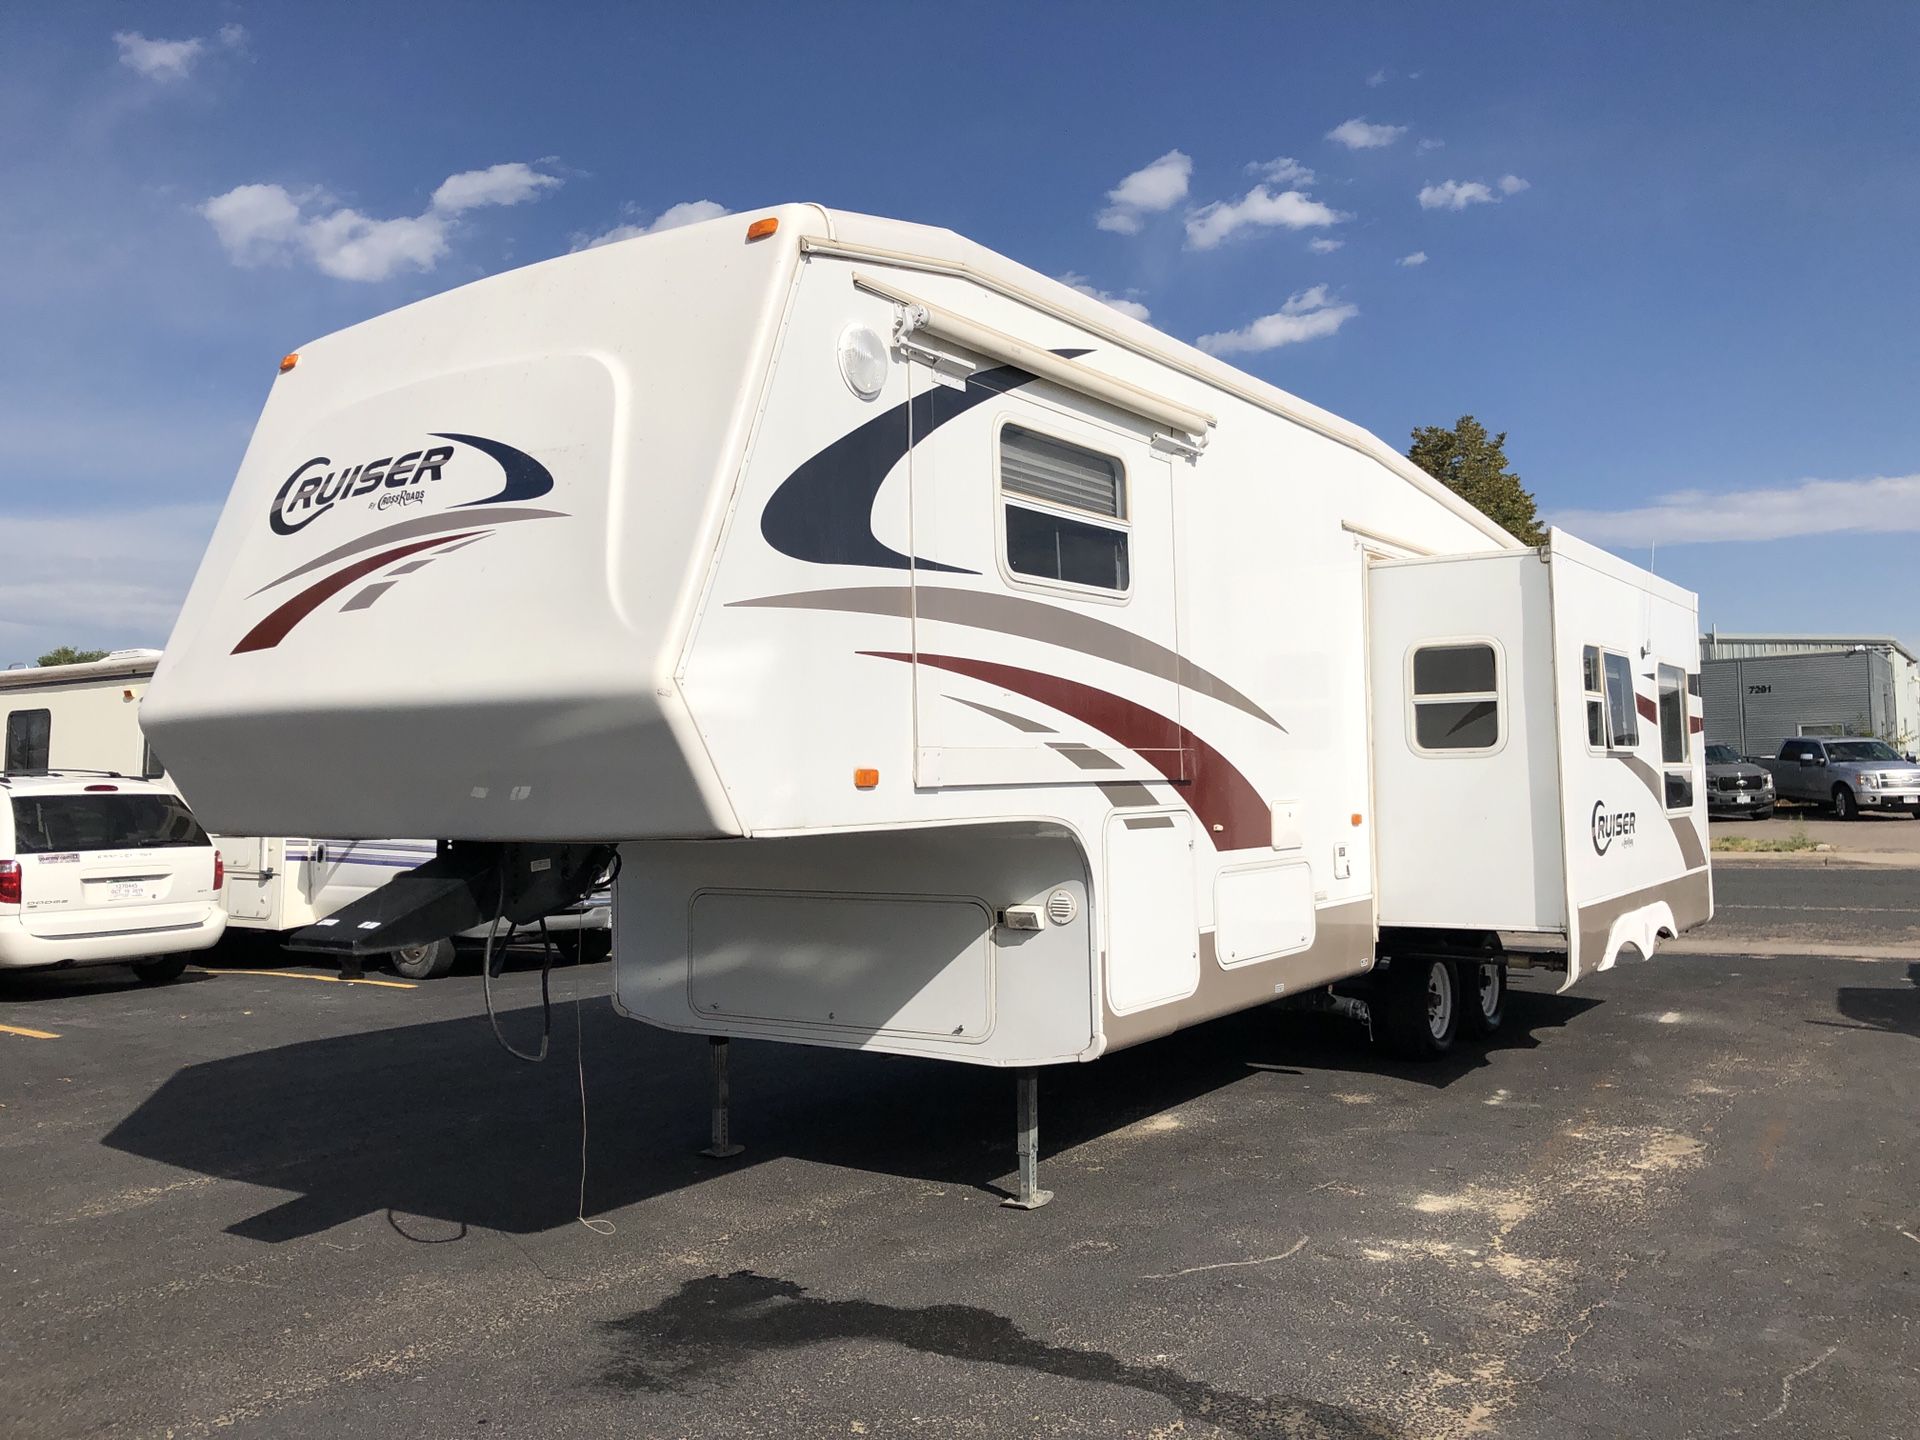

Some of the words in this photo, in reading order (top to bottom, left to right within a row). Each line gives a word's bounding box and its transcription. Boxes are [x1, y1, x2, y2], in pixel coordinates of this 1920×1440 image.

[270, 446, 454, 535] CRUISER
[1747, 685, 1771, 694] 7201
[1592, 800, 1636, 856] CRUISER
